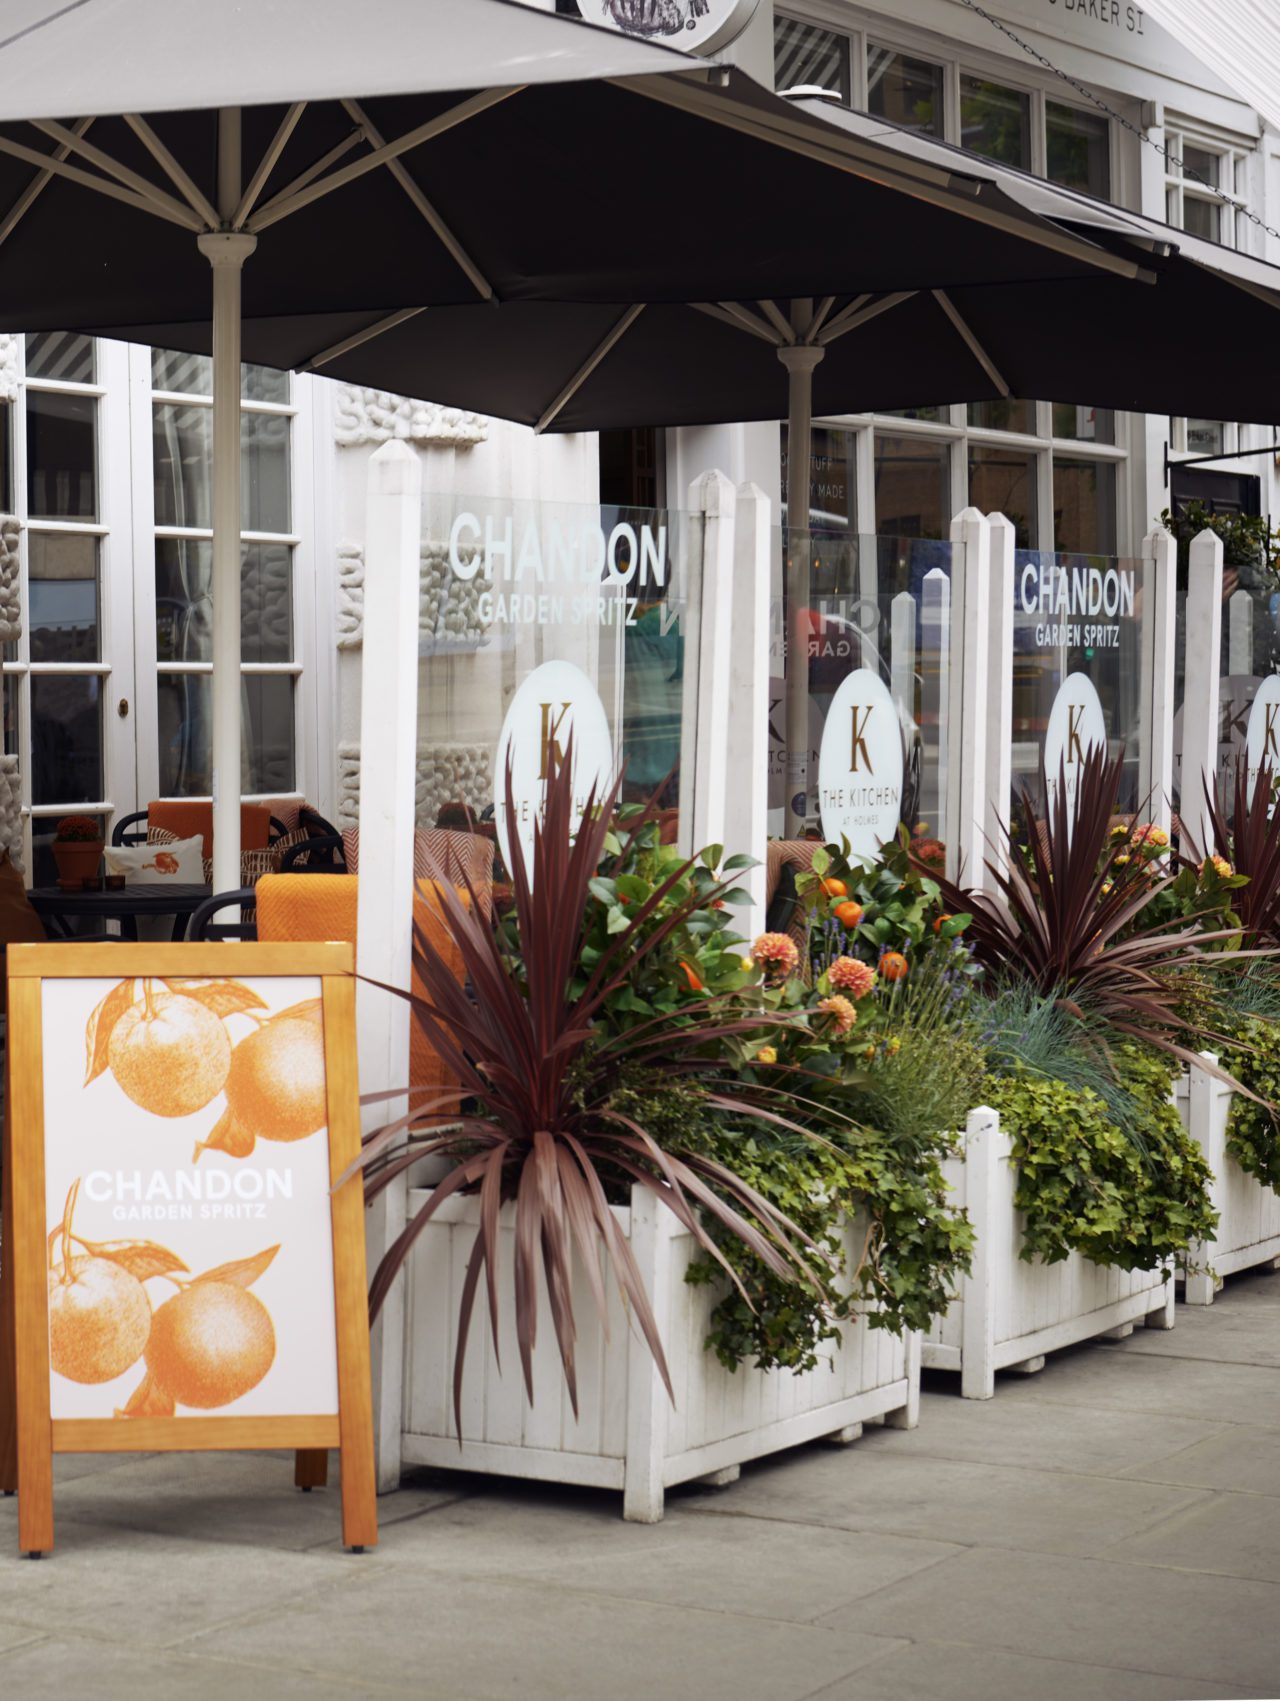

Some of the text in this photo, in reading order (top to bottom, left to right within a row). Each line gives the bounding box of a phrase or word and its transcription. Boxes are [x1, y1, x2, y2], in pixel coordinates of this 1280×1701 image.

[818, 484, 845, 499] MADE
[448, 512, 667, 588] CHANDON
[477, 592, 638, 627] GARDEN SPRITZ
[1021, 563, 1135, 617] CHANDON
[1035, 623, 1120, 648] GARDEN SPRITZ
[537, 702, 573, 780] K
[849, 705, 874, 776] K
[1067, 704, 1086, 768] K
[1218, 699, 1255, 745] K
[1265, 702, 1280, 760] K
[823, 786, 899, 808] THE KITCHEN
[83, 1167, 293, 1202] CHANDON
[112, 1203, 267, 1221] GARDEN SPRITZ
